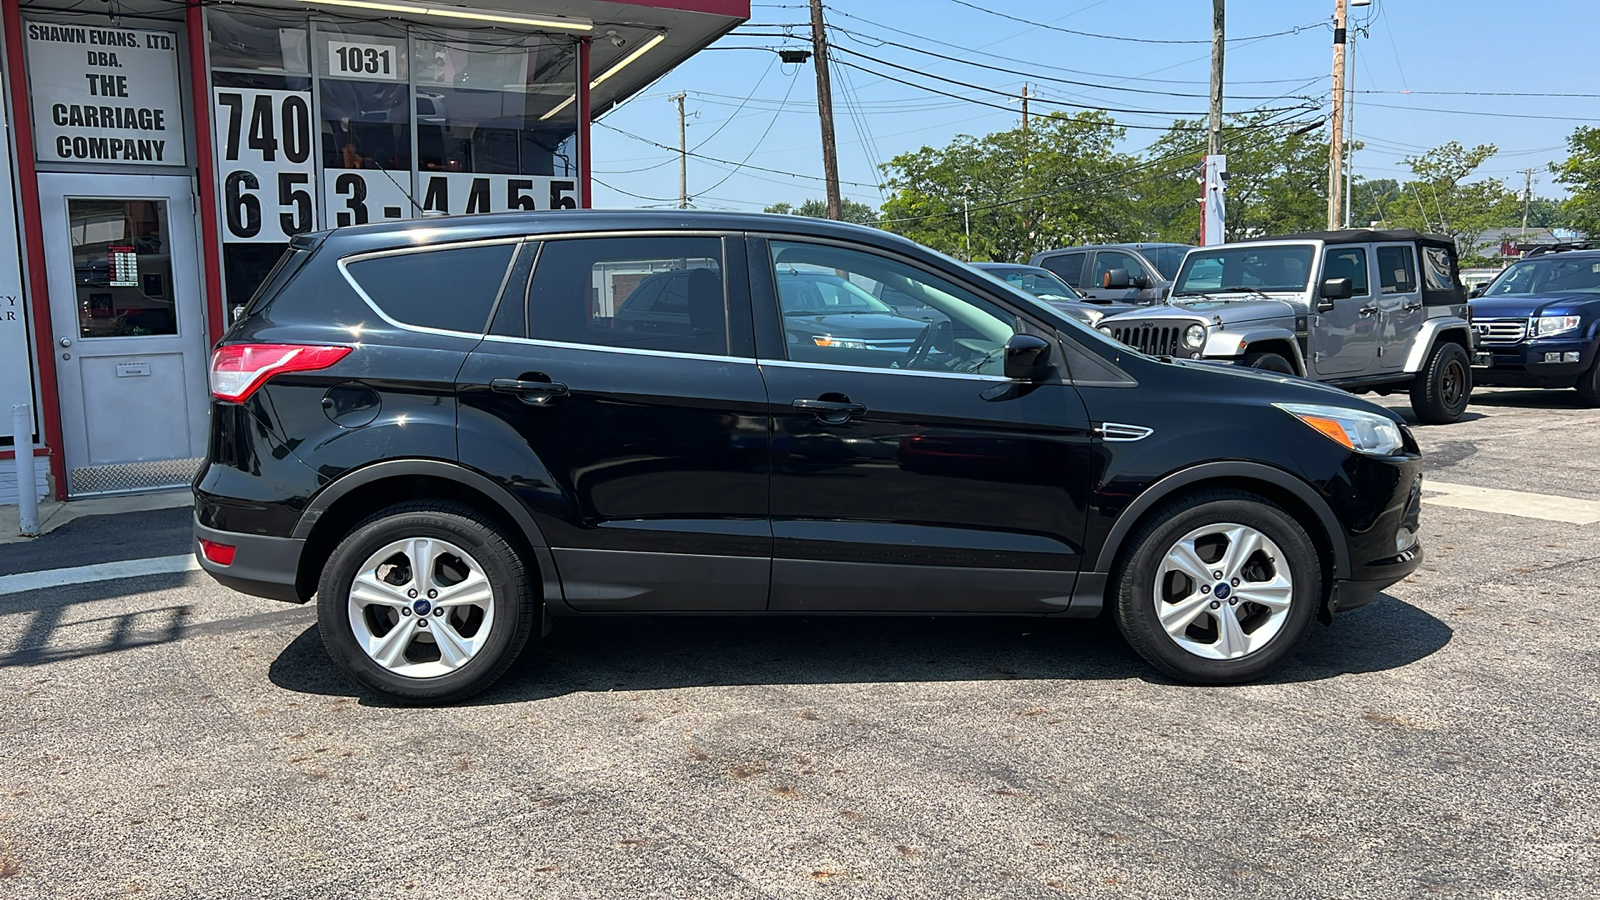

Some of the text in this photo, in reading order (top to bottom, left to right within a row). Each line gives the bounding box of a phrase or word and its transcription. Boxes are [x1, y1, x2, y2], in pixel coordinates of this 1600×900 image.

[29, 24, 175, 51] SHAWN EVANS. LTD.
[87, 51, 123, 68] DBA.
[336, 46, 391, 75] 1031
[86, 73, 129, 98] THE
[52, 103, 166, 131] CARRIAGE
[219, 92, 310, 164] 740
[56, 135, 166, 162] COMPANY
[0, 295, 17, 307] Y
